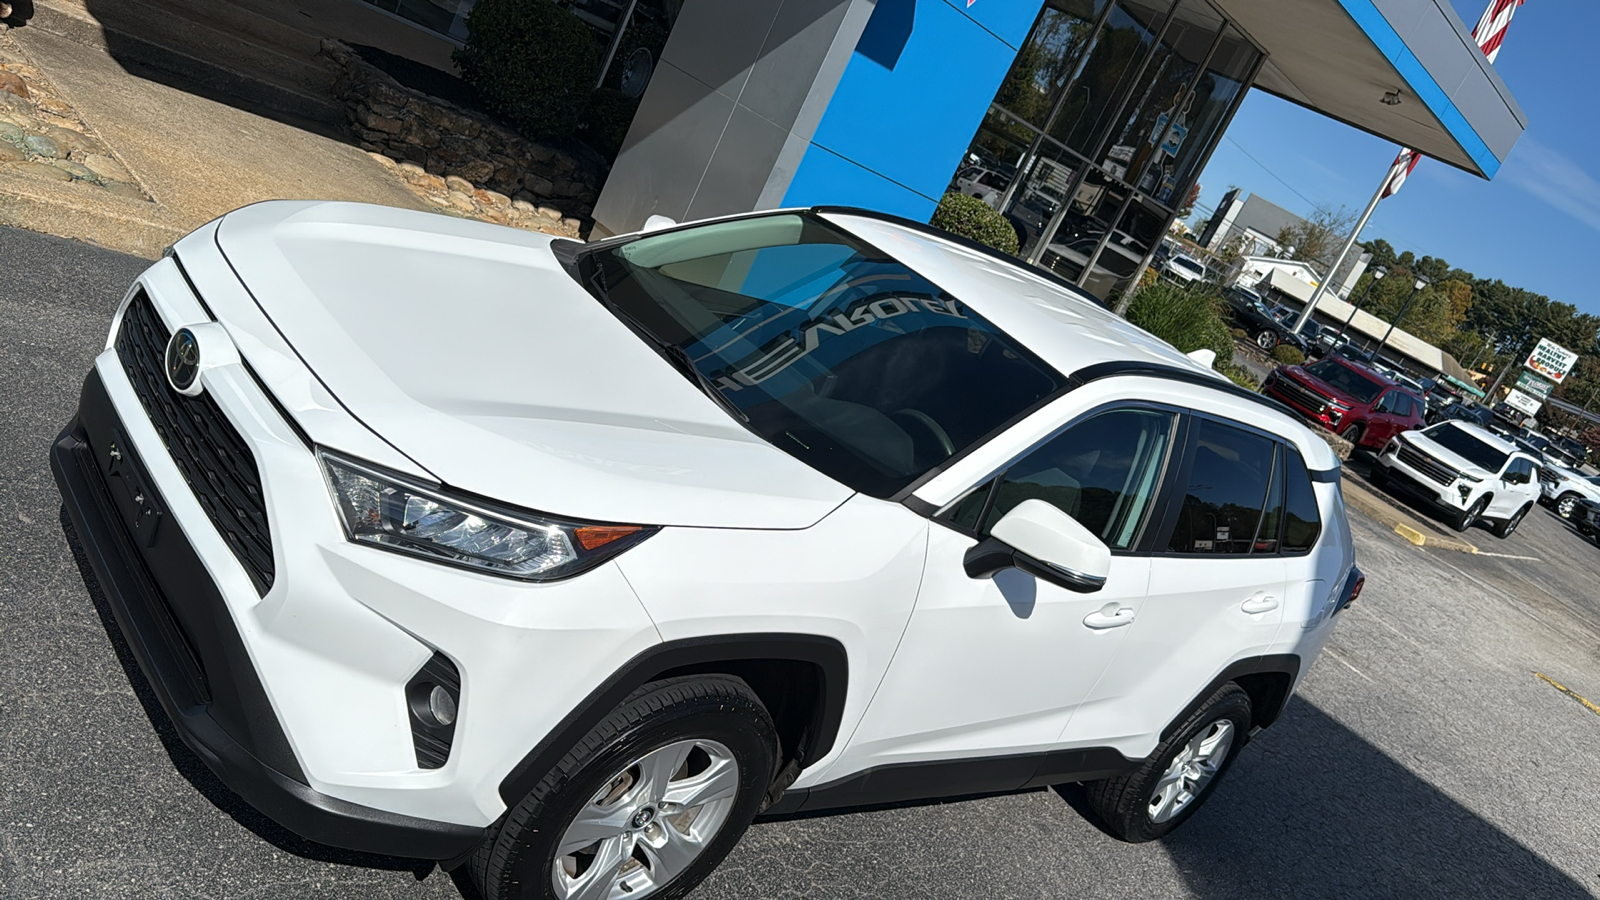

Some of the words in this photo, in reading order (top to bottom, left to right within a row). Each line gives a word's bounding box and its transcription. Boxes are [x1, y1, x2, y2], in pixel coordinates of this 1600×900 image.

[1537, 344, 1566, 361] HEALTHY
[1537, 351, 1567, 368] HARVEST
[1536, 357, 1567, 375] PRODUCE
